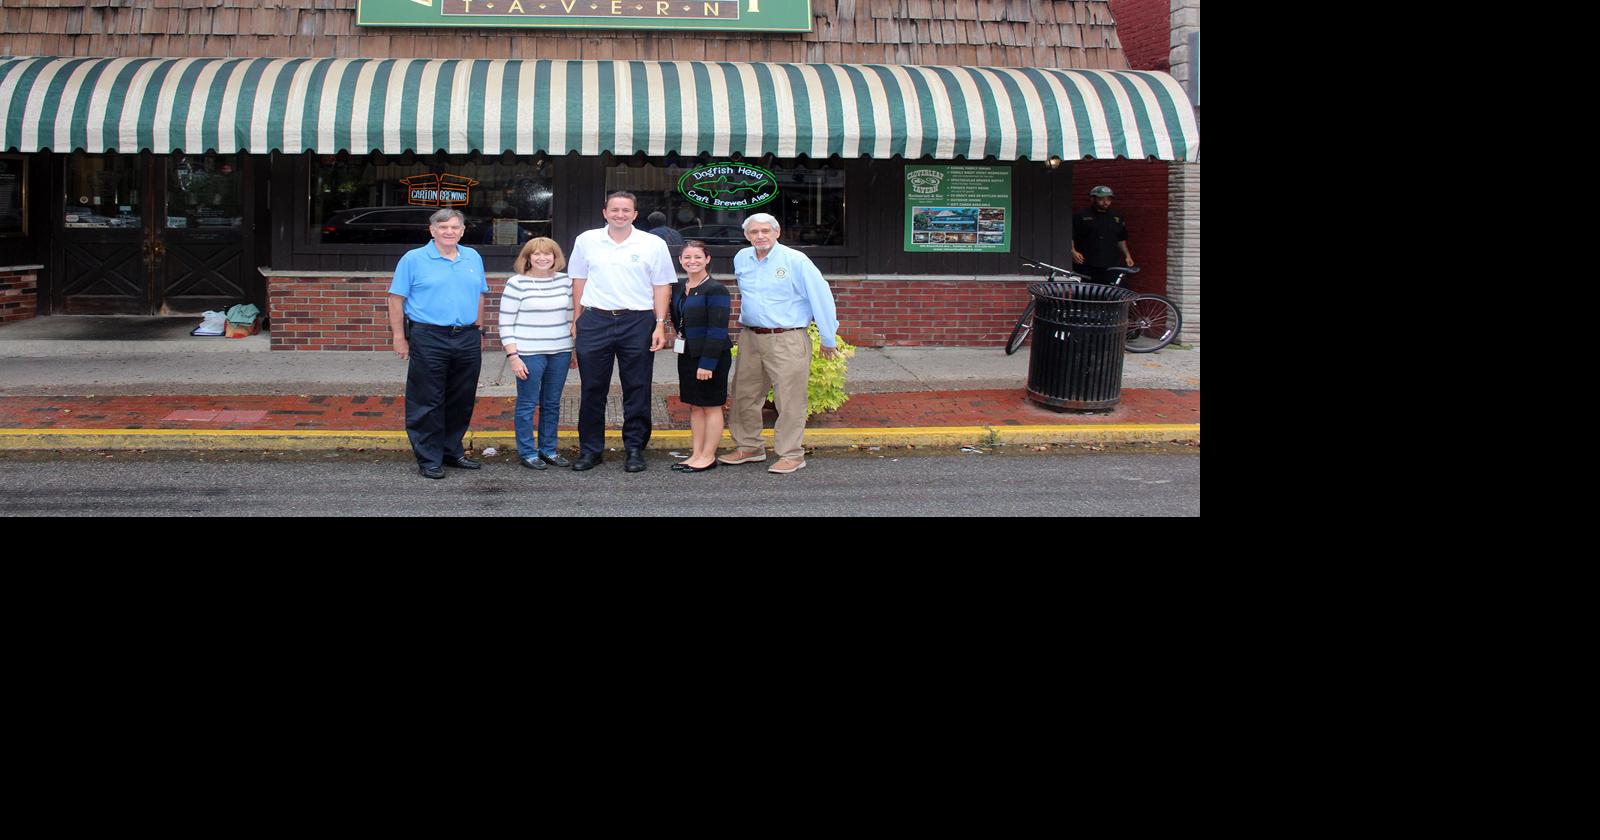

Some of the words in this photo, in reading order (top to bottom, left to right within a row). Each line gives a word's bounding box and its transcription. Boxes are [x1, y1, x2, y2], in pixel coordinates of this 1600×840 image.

[693, 166, 733, 180] Dogfish
[738, 166, 763, 180] Head
[411, 189, 438, 200] CARTON
[439, 190, 467, 201] BREWING
[687, 189, 709, 204] Craft
[713, 198, 747, 206] Brewed
[751, 192, 770, 203] Ales
